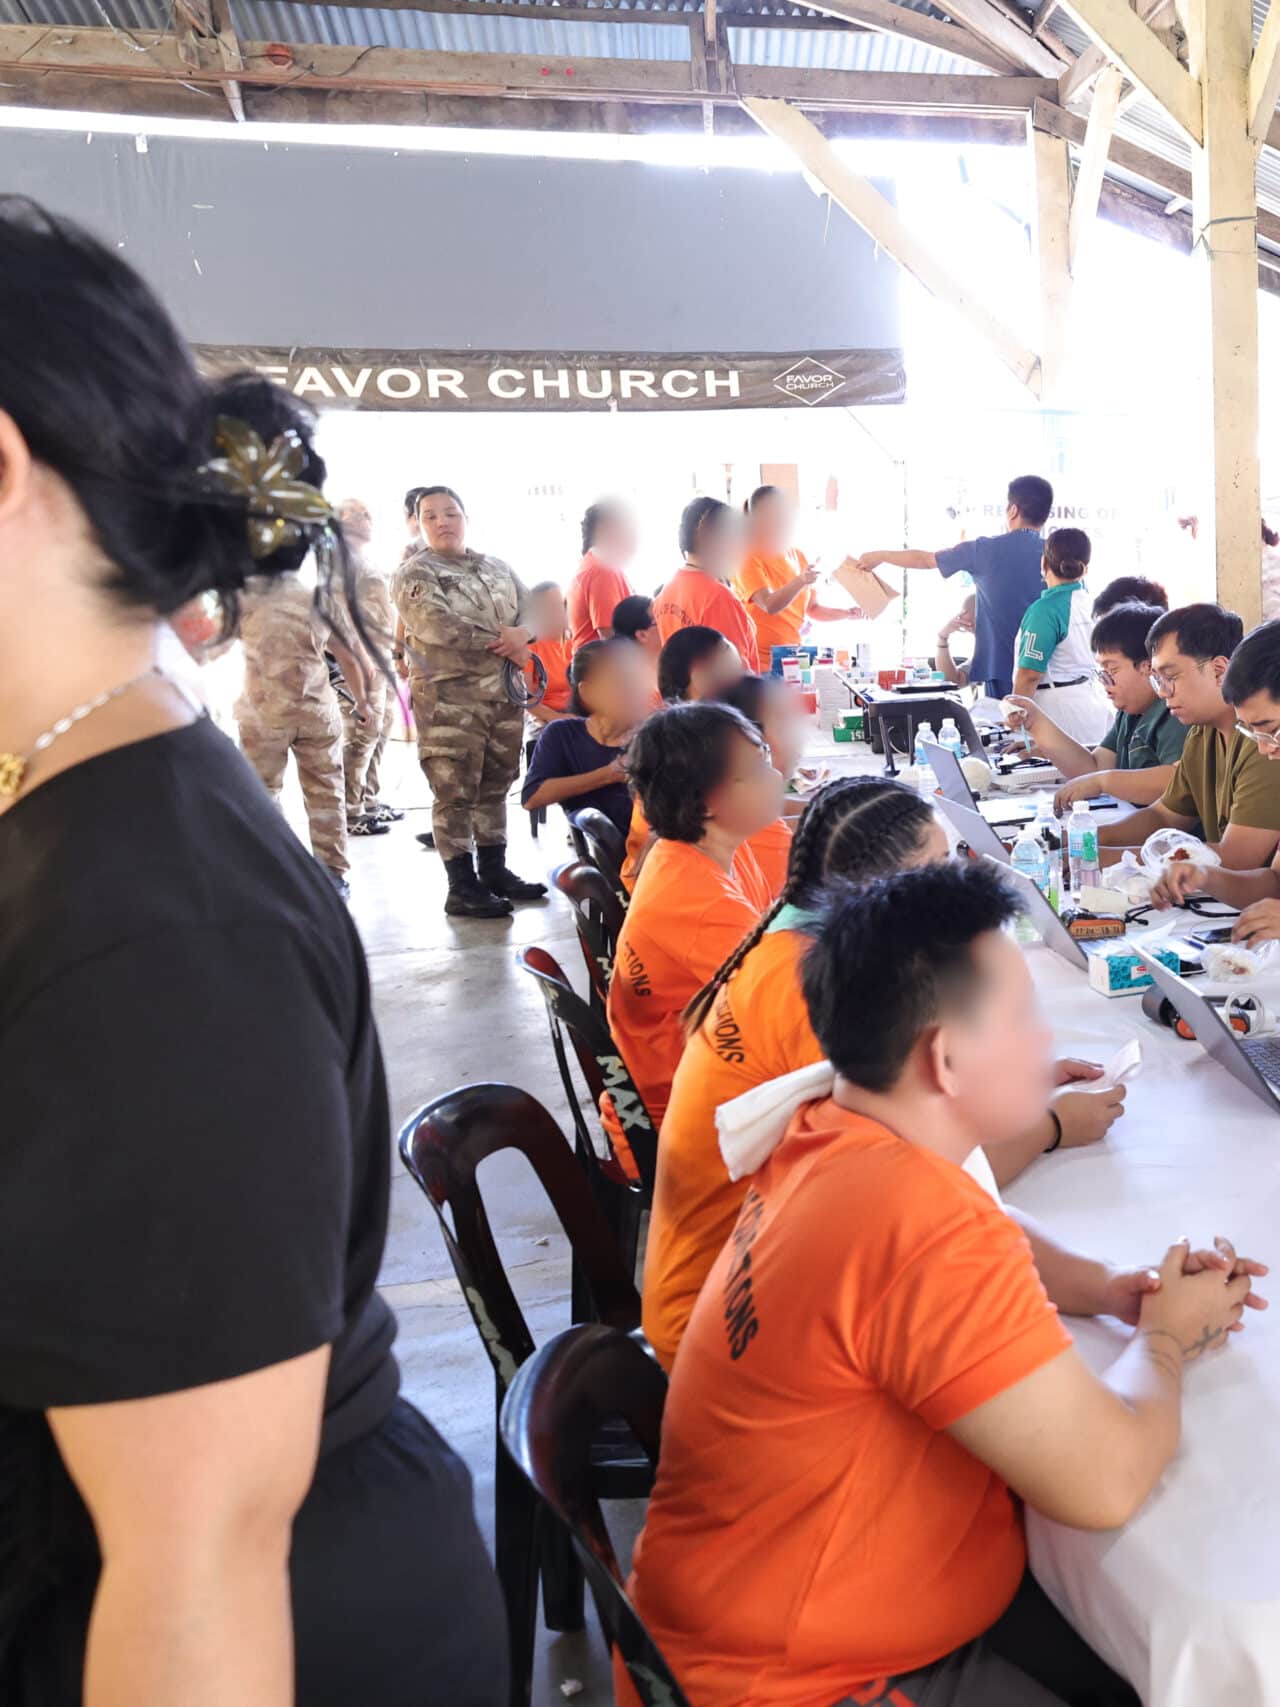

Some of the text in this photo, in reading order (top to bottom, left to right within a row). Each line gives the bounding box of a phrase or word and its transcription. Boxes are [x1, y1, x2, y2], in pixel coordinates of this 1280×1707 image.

[256, 366, 741, 398] FAVOR CHURCH
[786, 375, 832, 383] FAVOR
